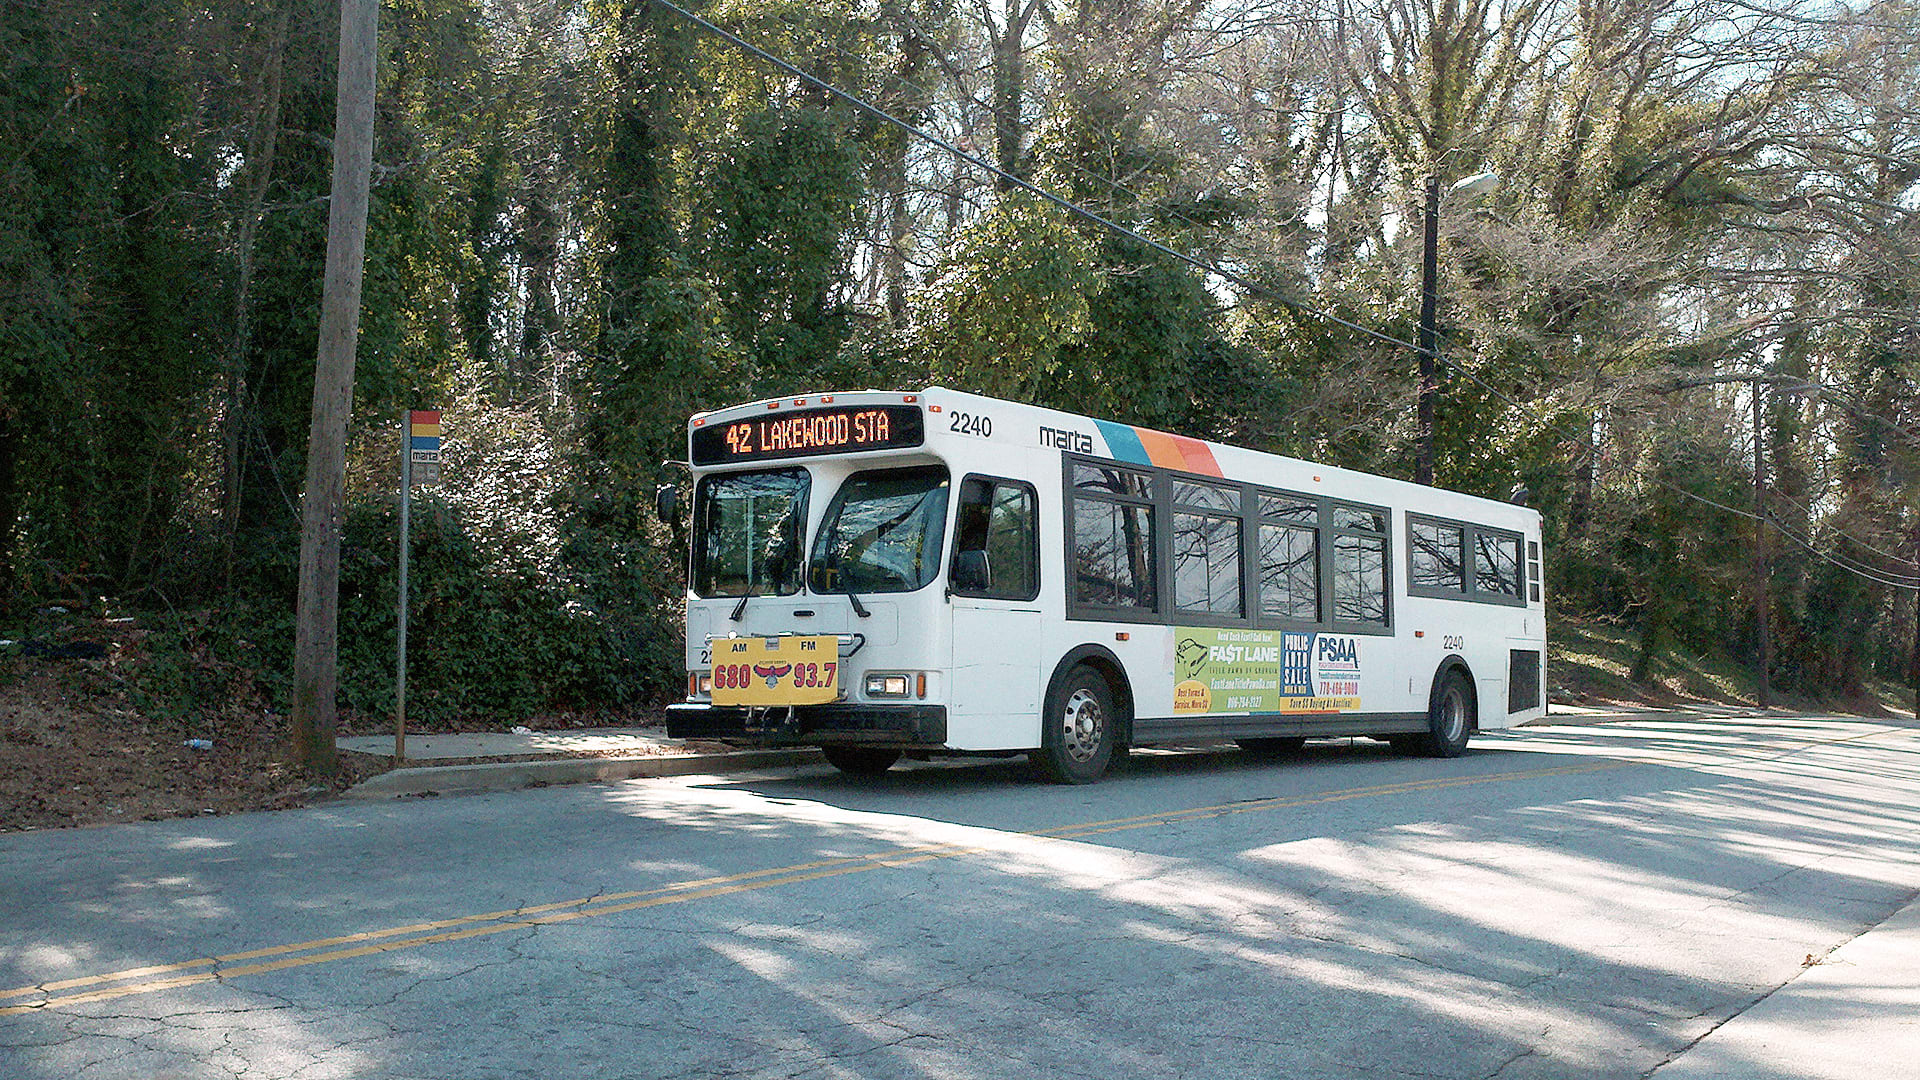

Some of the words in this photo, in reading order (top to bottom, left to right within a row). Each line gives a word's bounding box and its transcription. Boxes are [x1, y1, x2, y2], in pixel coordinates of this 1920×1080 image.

[726, 423, 752, 454] 42
[760, 413, 849, 451] LAKEWOOD
[854, 411, 889, 442] STA
[949, 410, 993, 438] 2240
[1039, 425, 1093, 454] marta
[412, 451, 438, 461] marta
[731, 642, 747, 652] AM
[800, 640, 816, 651] FM
[1285, 635, 1309, 651] PUBLIC
[1443, 635, 1463, 650] 2240
[1209, 644, 1244, 664] FA$T
[1244, 646, 1279, 662] LANE
[1284, 651, 1308, 668] AUTO
[1319, 637, 1359, 669] PSAA
[714, 664, 751, 689] 680
[793, 662, 836, 688] 93.7
[1284, 668, 1308, 685] SALE
[1289, 698, 1302, 709] Save
